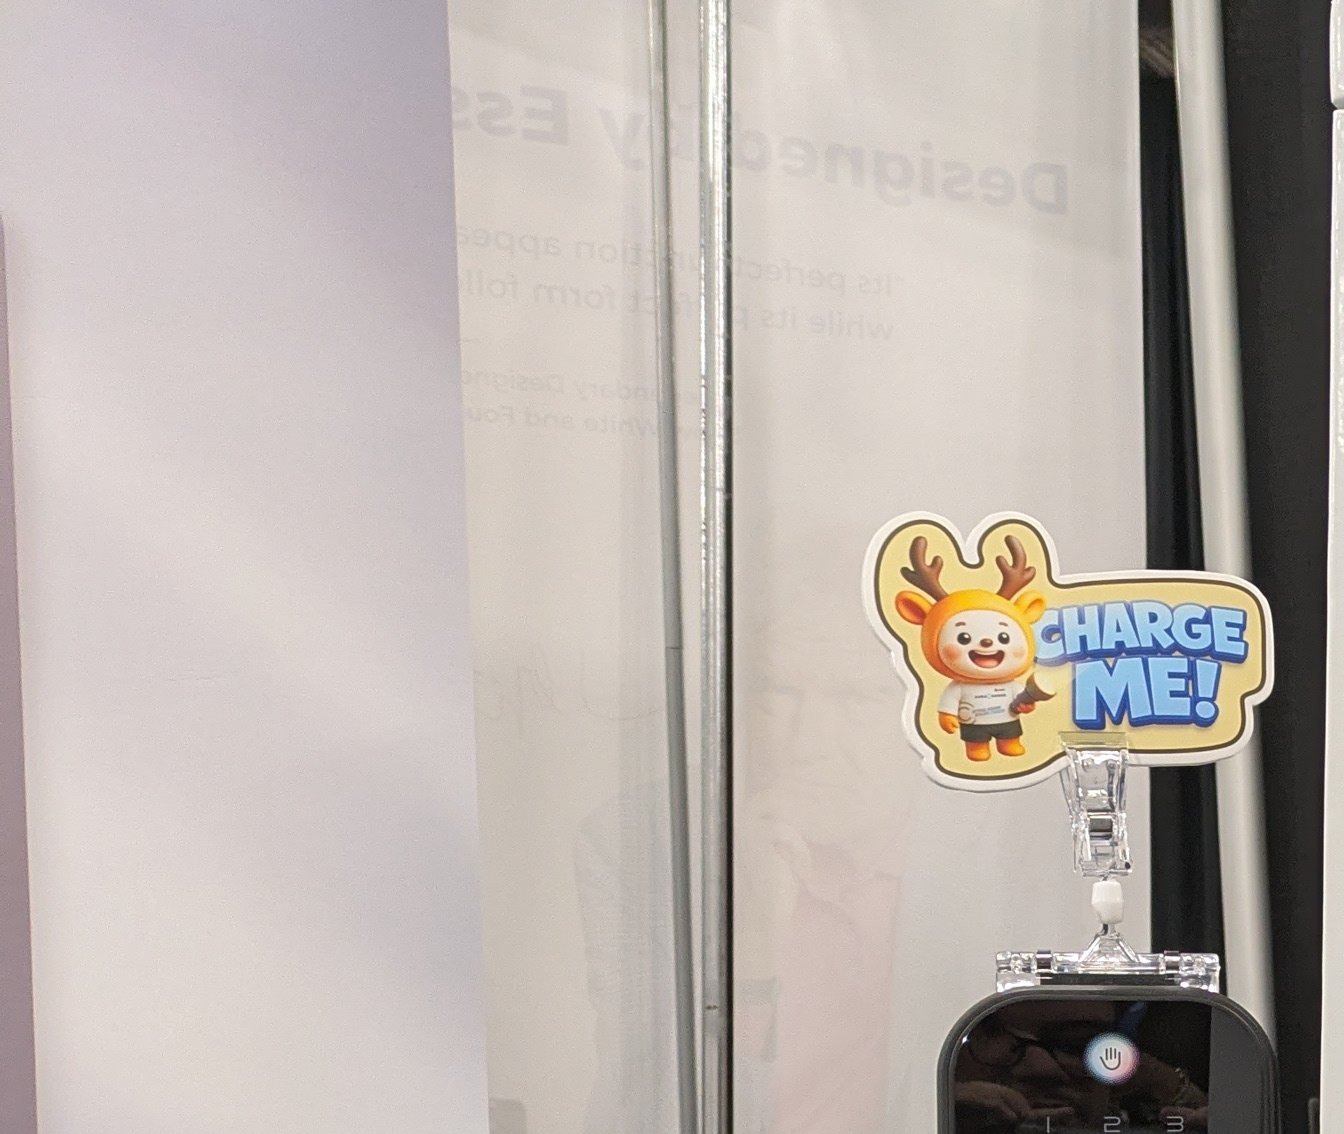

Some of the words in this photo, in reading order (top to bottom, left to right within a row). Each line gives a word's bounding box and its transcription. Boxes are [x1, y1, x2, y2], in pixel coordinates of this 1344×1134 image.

[1034, 601, 1249, 666] CHARGE
[1073, 656, 1222, 730] ME!
[1103, 1116, 1121, 1133] 2
[1166, 1116, 1184, 1133] 3
